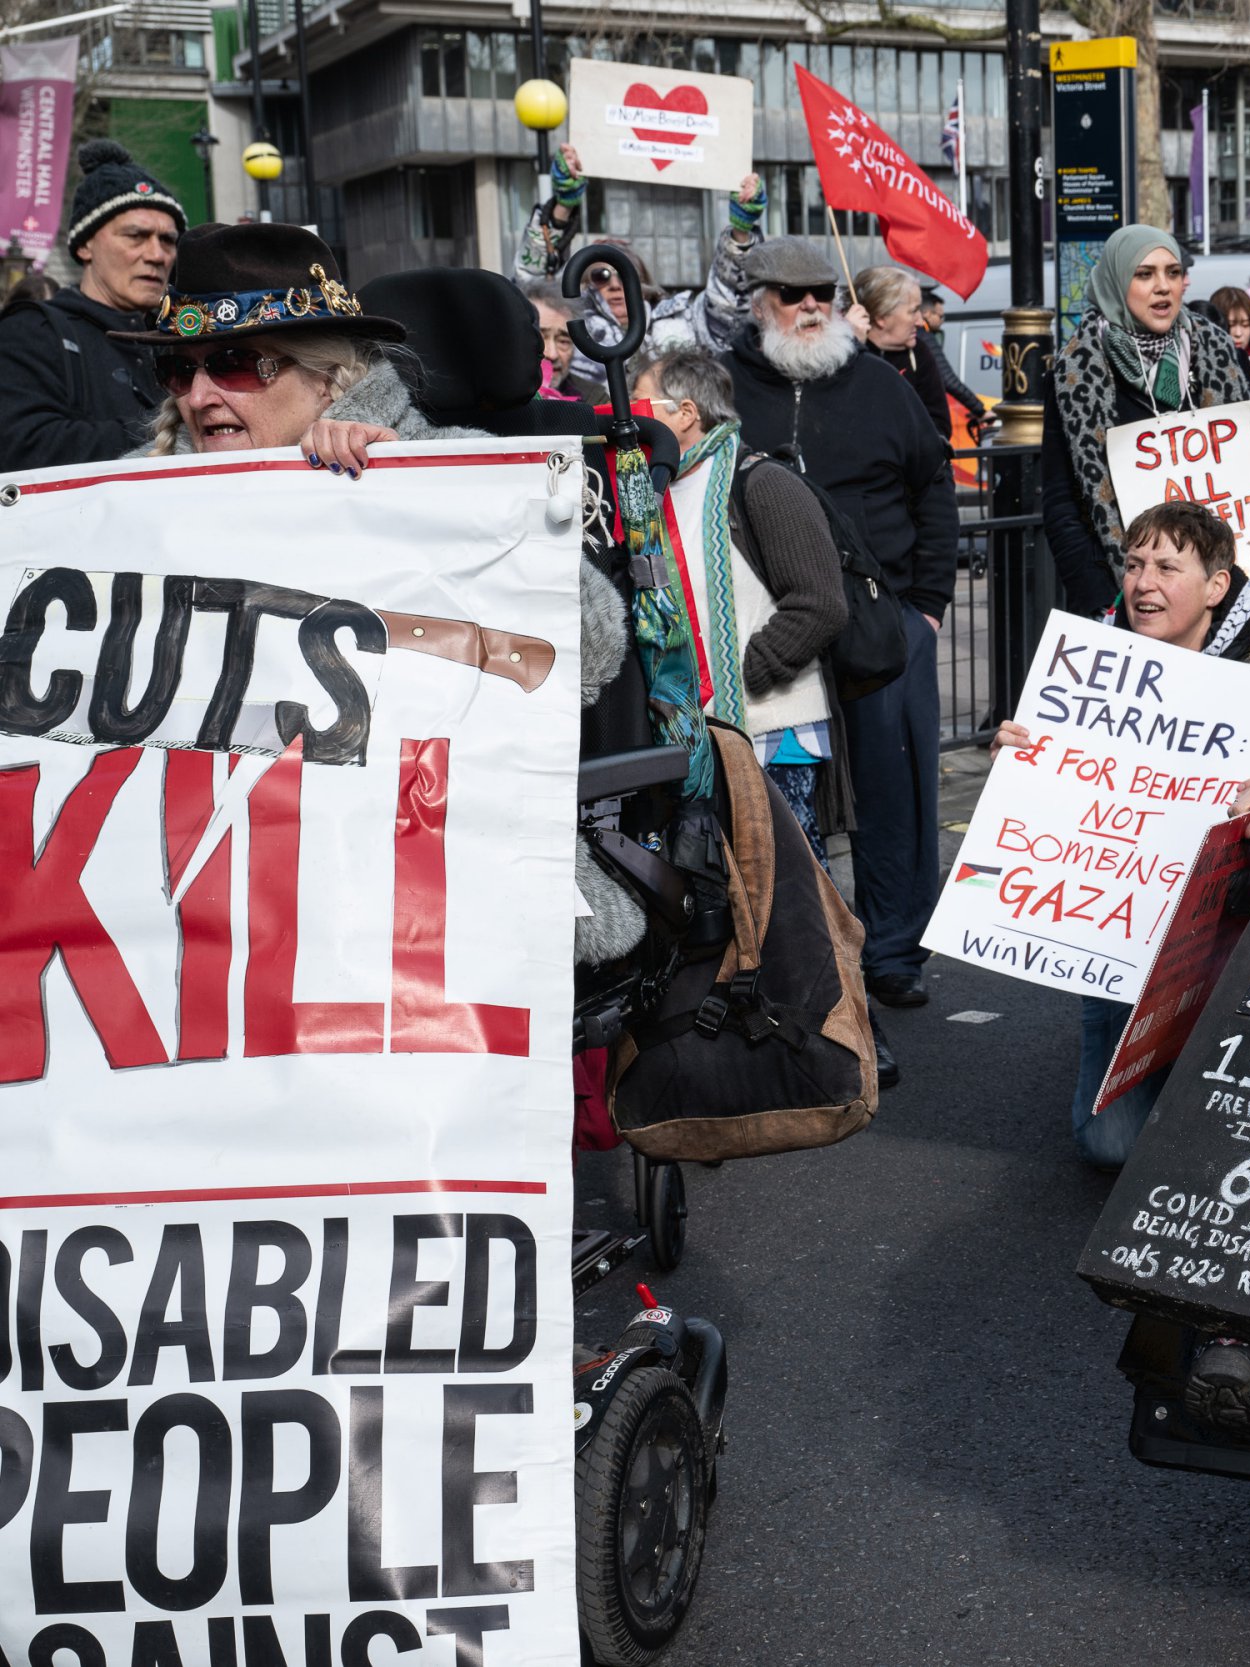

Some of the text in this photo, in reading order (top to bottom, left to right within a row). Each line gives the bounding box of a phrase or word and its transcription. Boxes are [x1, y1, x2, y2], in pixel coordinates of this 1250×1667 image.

[16, 86, 35, 198] WESTMINSTER
[34, 86, 56, 207] CENTRAL HALL
[1135, 419, 1237, 470] STOP
[1165, 473, 1231, 505] ALL
[0, 567, 388, 766] CUTS
[1047, 633, 1164, 702] KEIR
[1036, 685, 1248, 759] STARMER:
[1015, 735, 1242, 807] £ FOR BENEFIT
[1082, 800, 1165, 836] NOT
[996, 817, 1186, 893] BOMBING
[0, 738, 530, 1083] KILL
[963, 929, 1124, 995] WinVisible
[1132, 1210, 1199, 1248] BEING
[1148, 1185, 1235, 1226] COVID
[0, 1213, 537, 1391] ISABLED
[1166, 1255, 1225, 1286] 2020
